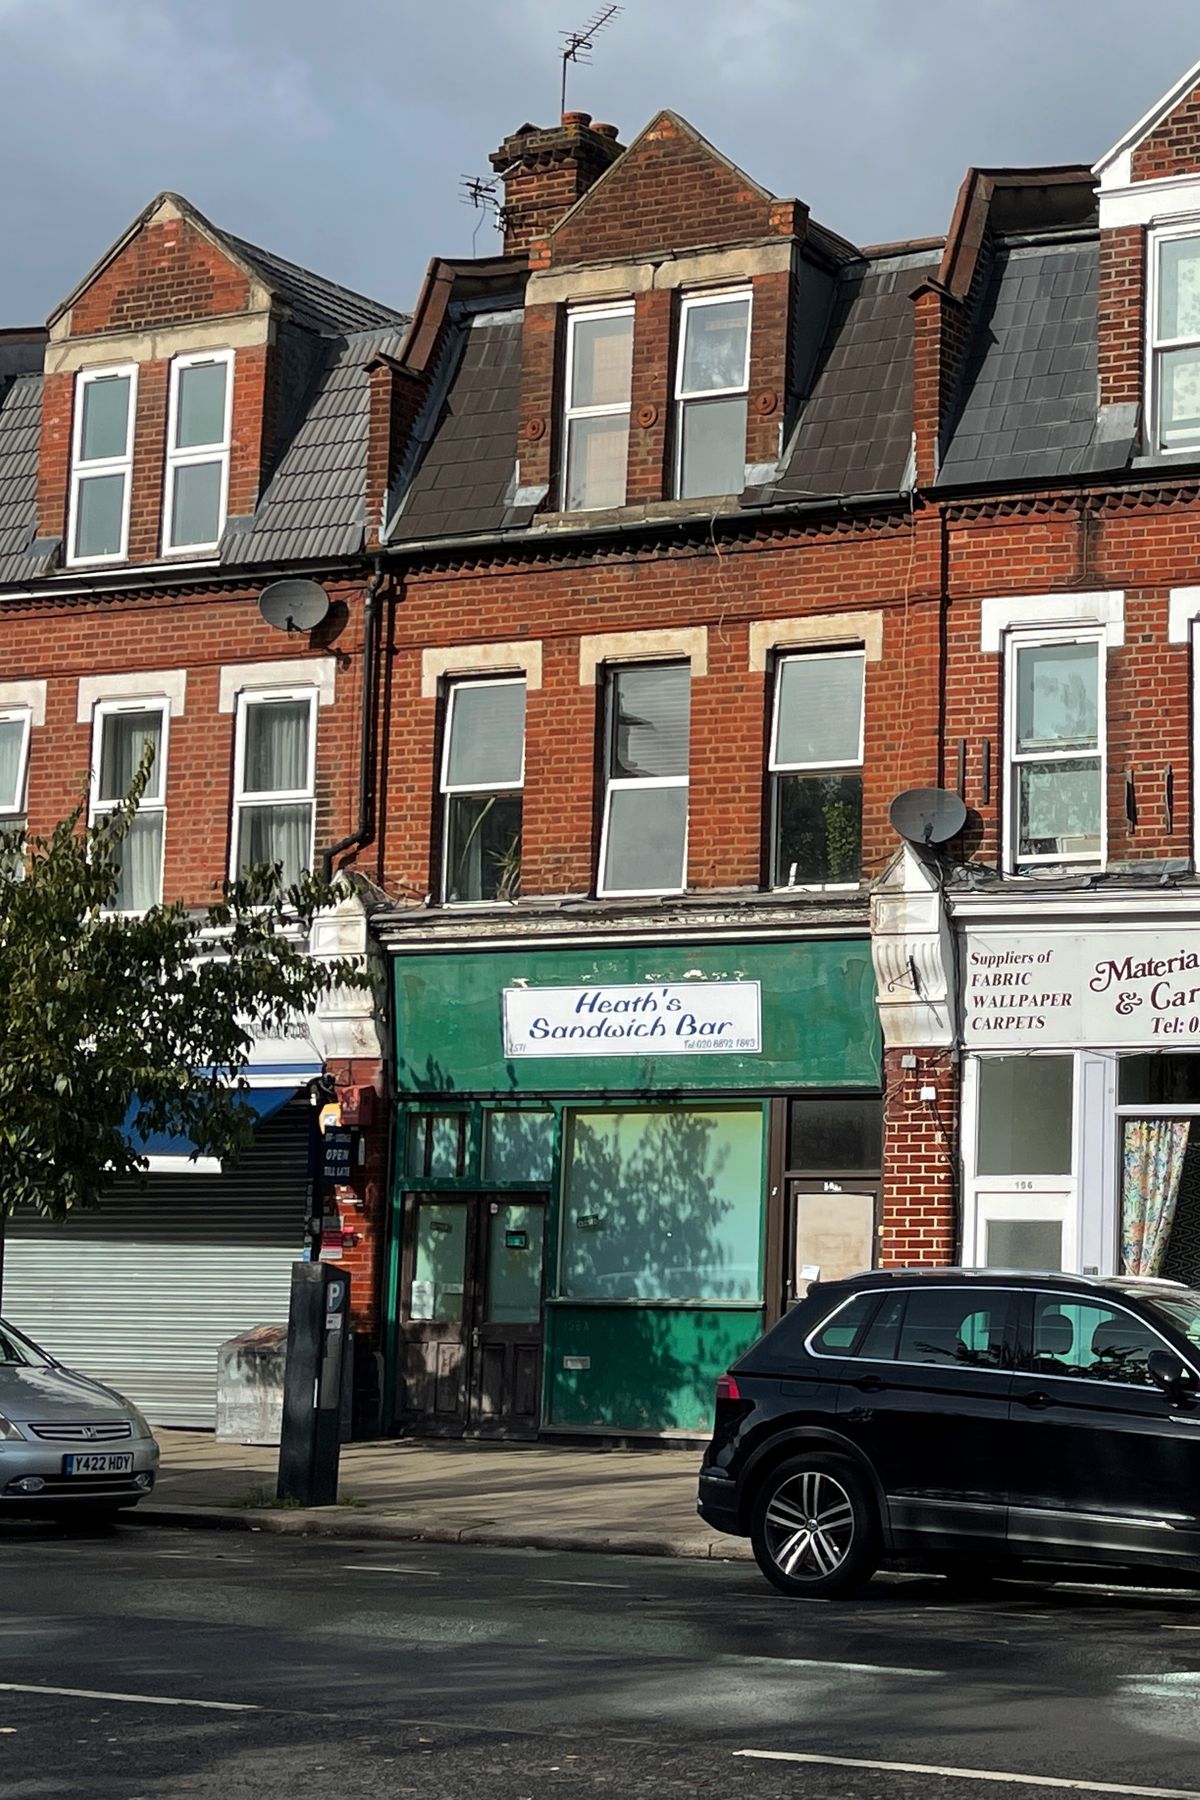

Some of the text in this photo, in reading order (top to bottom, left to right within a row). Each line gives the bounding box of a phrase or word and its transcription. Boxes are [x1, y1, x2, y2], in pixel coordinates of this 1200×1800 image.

[970, 949, 1054, 968] Suppliers of
[971, 972, 1032, 987] FABRIC
[575, 989, 682, 1014] Heath's
[972, 993, 1073, 1008] WALLPAPER
[1115, 992, 1143, 1015] &
[529, 1014, 733, 1039] Sandwich Bar
[972, 1015, 1046, 1030] CARPETS
[1151, 1016, 1184, 1034] Tel:
[325, 1148, 350, 1160] OPEN
[329, 1283, 340, 1307] P
[75, 1455, 131, 1471] Y422 HDY
